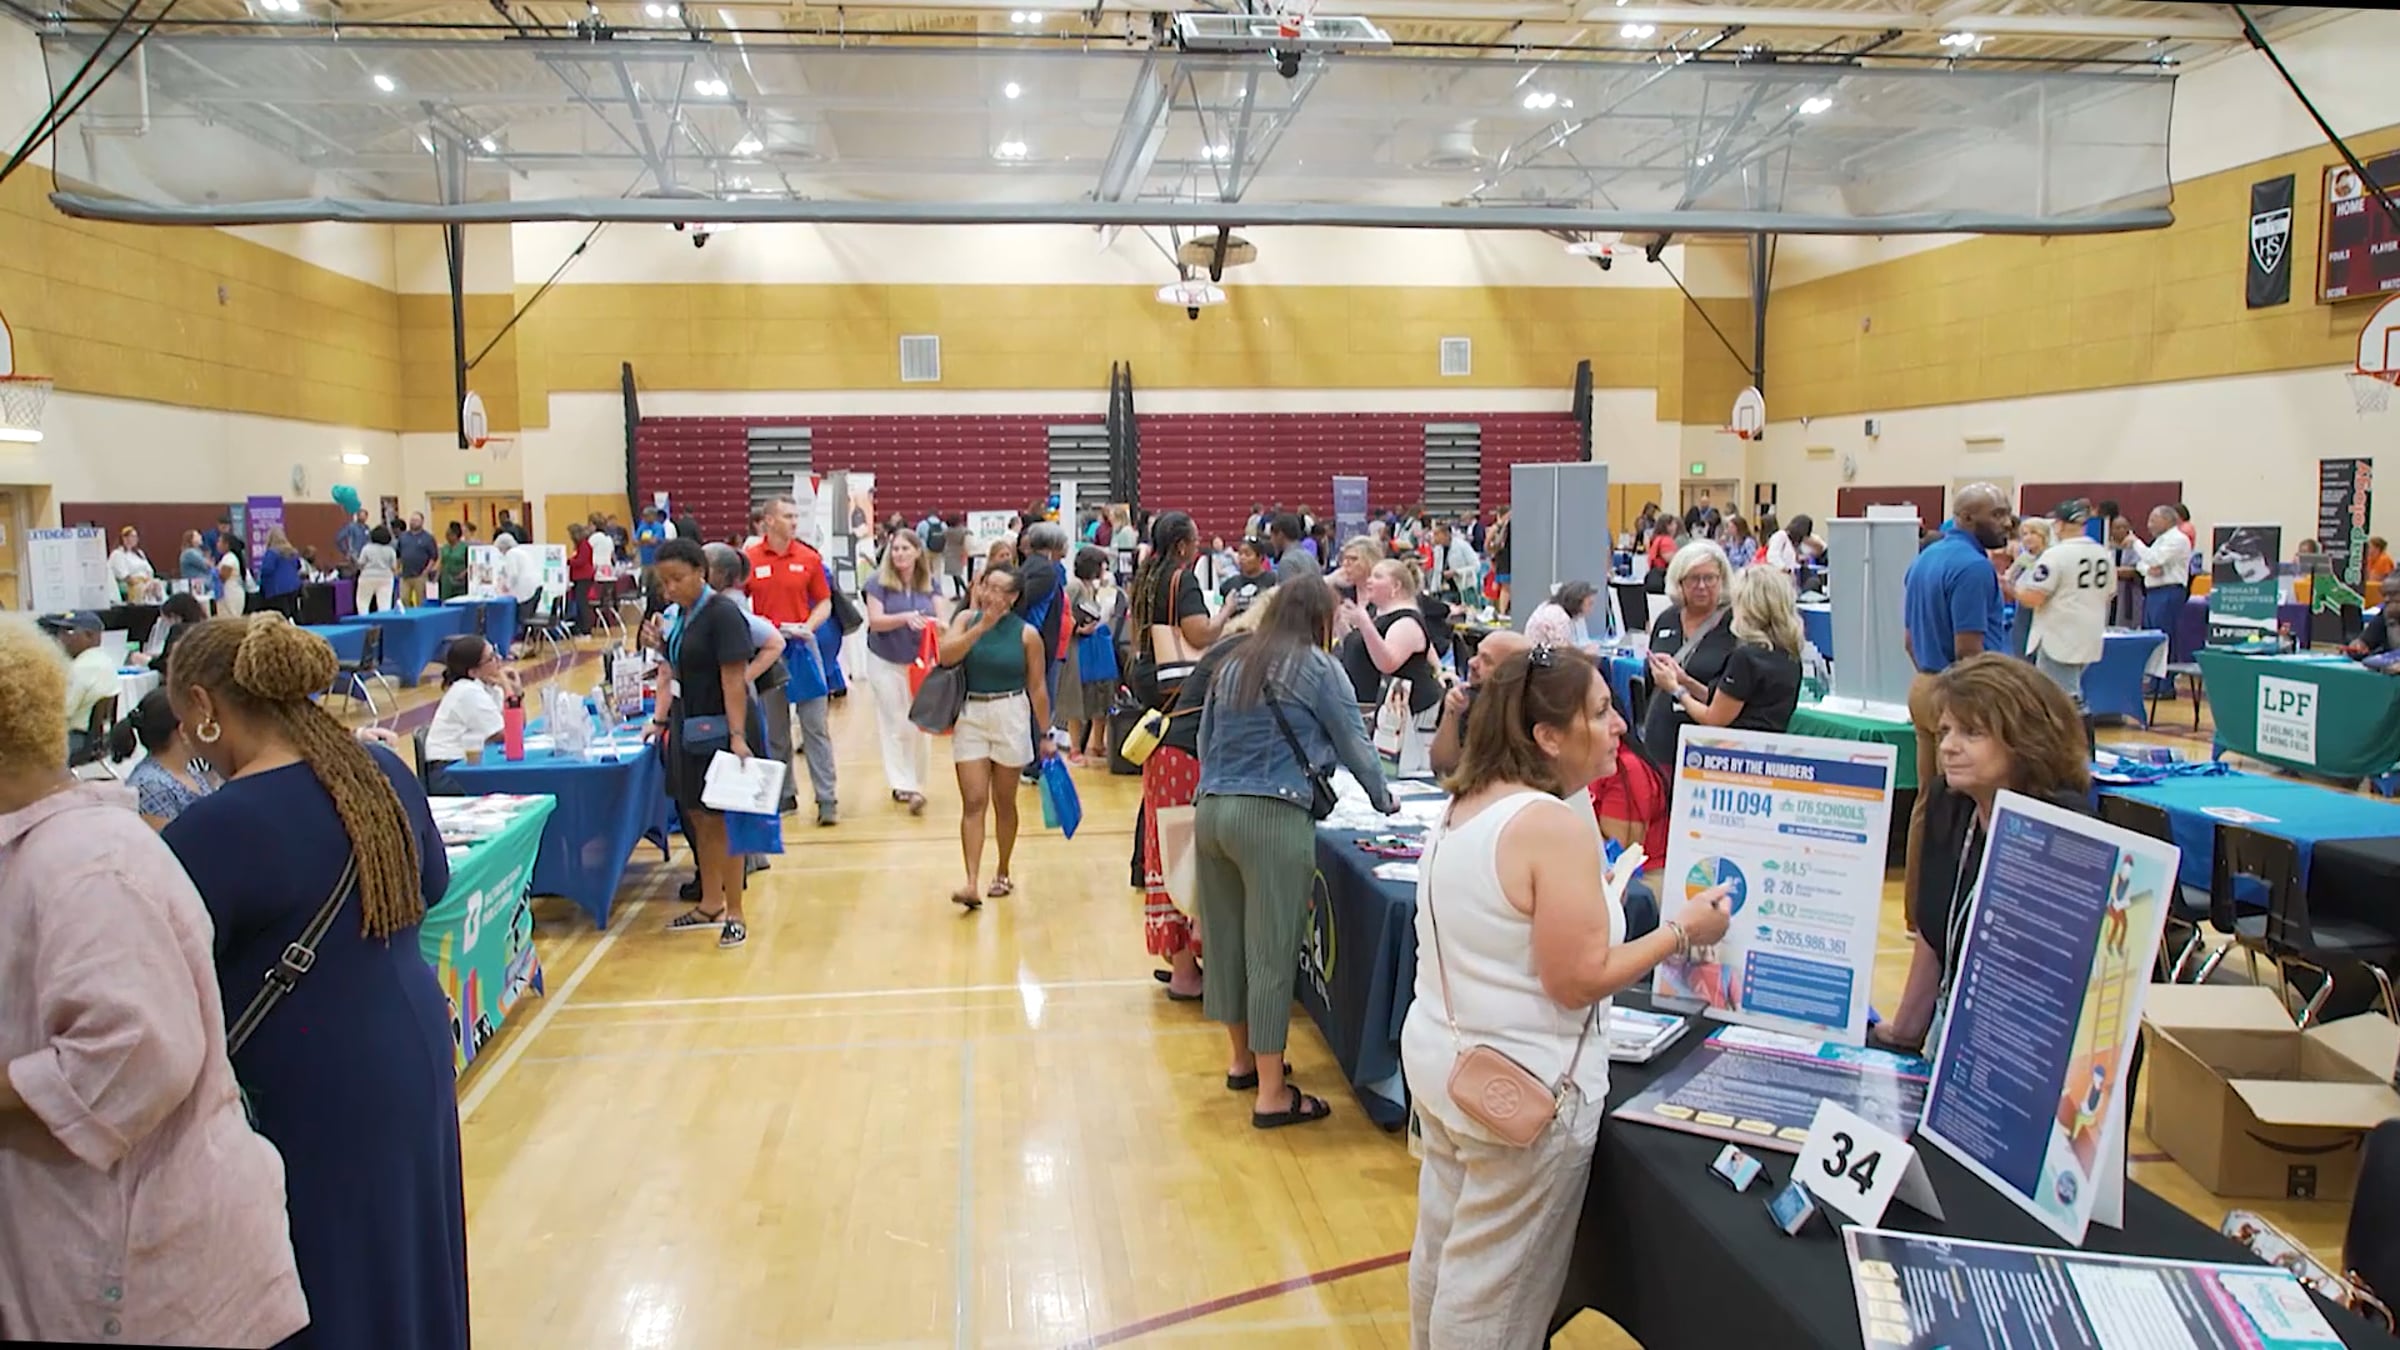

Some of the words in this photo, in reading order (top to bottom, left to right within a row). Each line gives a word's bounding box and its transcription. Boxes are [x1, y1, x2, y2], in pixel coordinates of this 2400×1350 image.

[2336, 200, 2365, 217] HOME
[2260, 236, 2281, 257] HS
[2370, 241, 2398, 255] PLAYER
[2328, 250, 2350, 262] FOULS
[2344, 460, 2372, 584] Snapology
[77, 528, 98, 539] DAY
[2078, 558, 2109, 588] 28
[2221, 586, 2260, 595] DONATE
[2221, 604, 2245, 612] PLAY
[2212, 627, 2233, 637] LPF
[2264, 687, 2311, 716] LPF
[2262, 721, 2295, 737] LEVELING
[2296, 729, 2309, 741] THE
[2262, 734, 2289, 748] PLAYING
[2290, 740, 2309, 752] FIELD
[1704, 756, 1729, 770] BCPS
[1731, 759, 1744, 772] BY
[1745, 761, 1764, 774] THE
[1765, 764, 1815, 781] NUMBERS
[1708, 814, 1746, 828] STUDENTS
[1777, 903, 1797, 918] 432
[1823, 1132, 1882, 1195] 34
